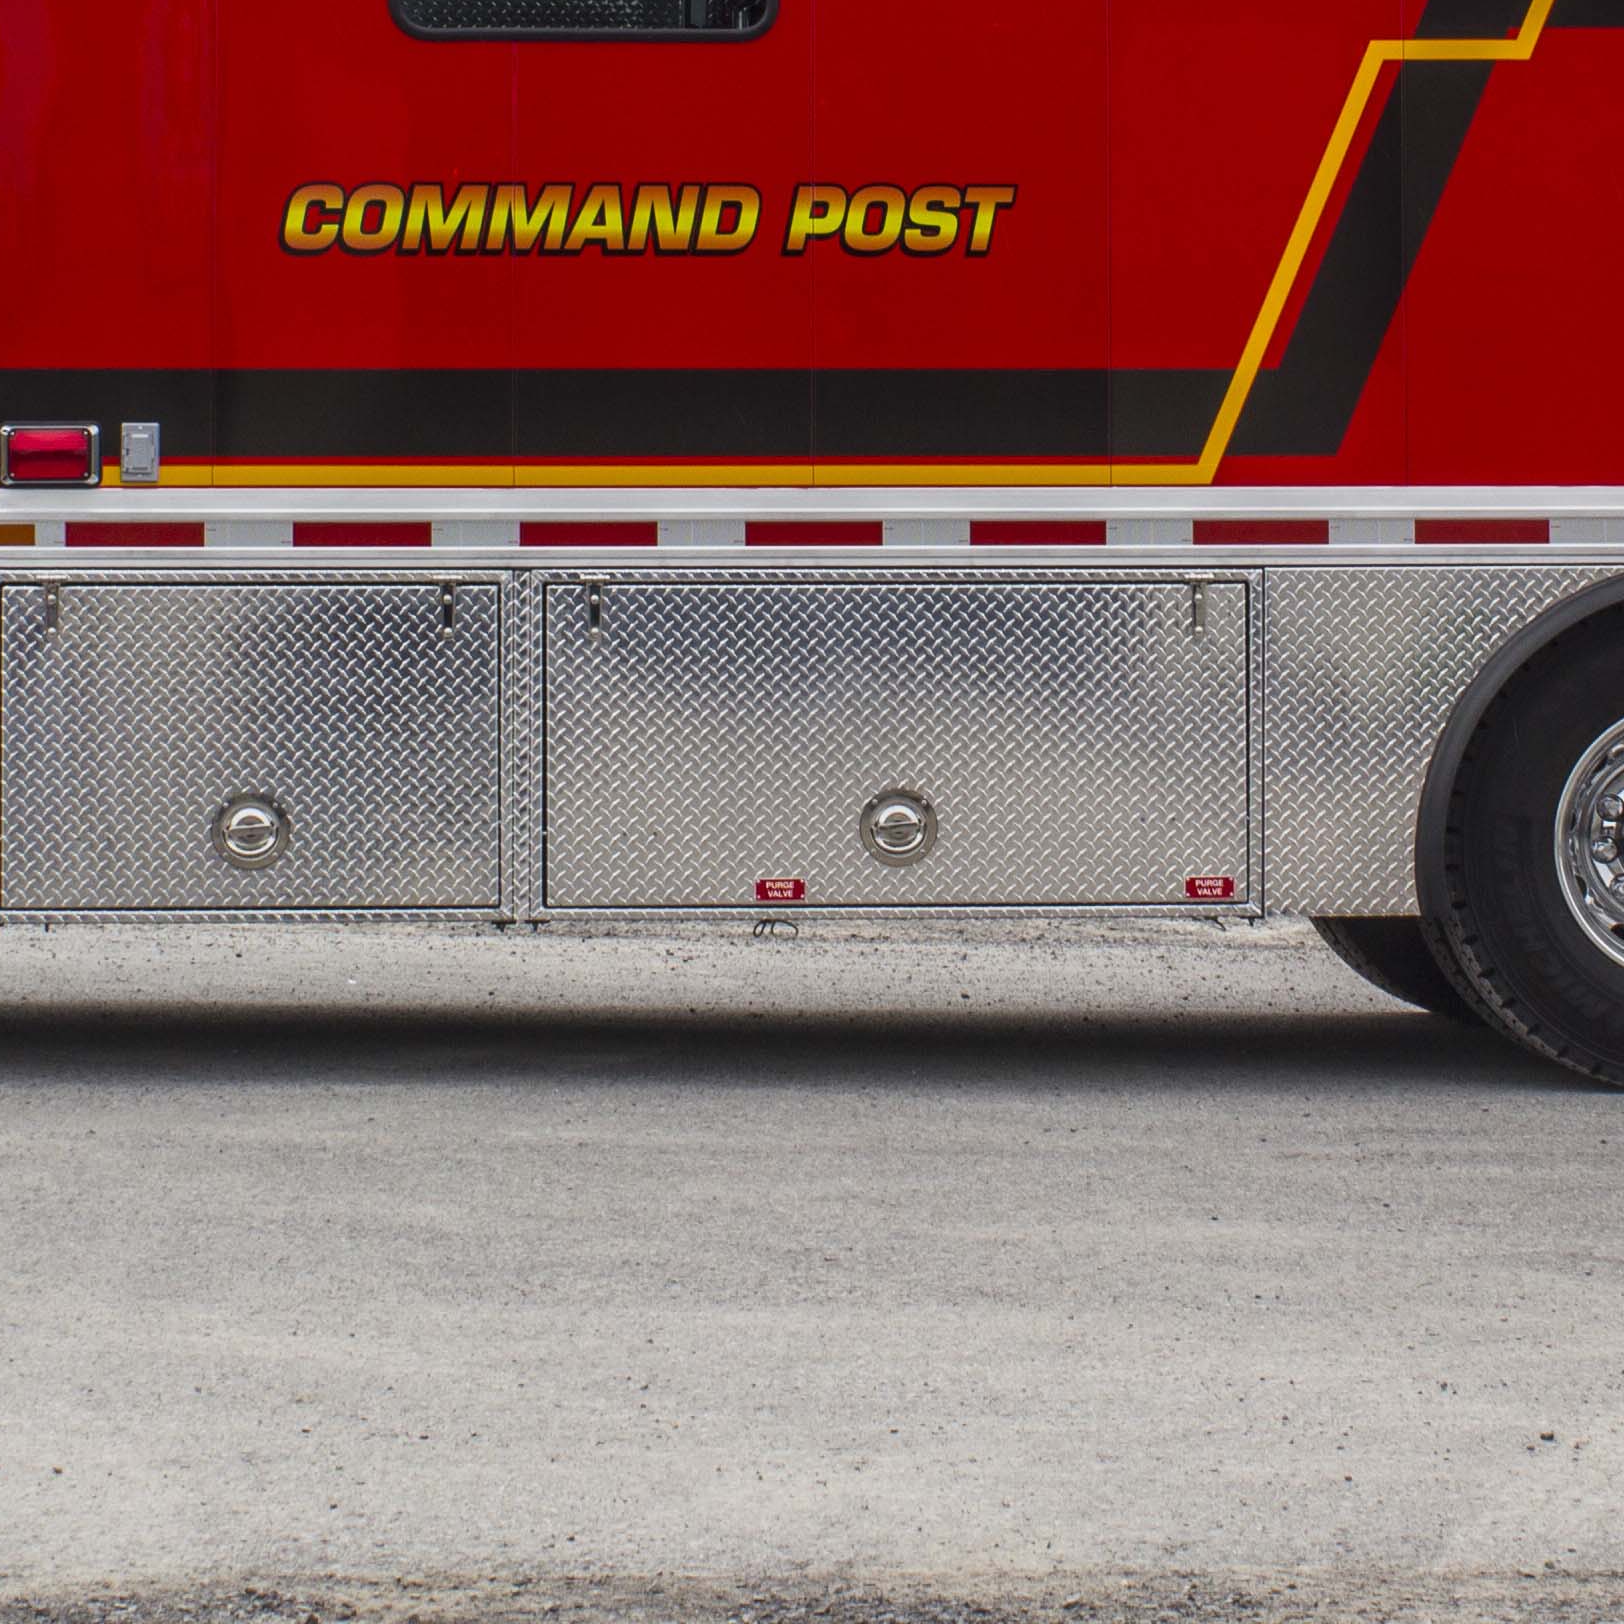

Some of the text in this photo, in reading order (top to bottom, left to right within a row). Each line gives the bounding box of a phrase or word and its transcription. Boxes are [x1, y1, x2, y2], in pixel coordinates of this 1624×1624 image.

[278, 181, 1018, 257] COMMAND POST
[767, 890, 793, 898] VALVE
[1196, 888, 1223, 896] VALVE
